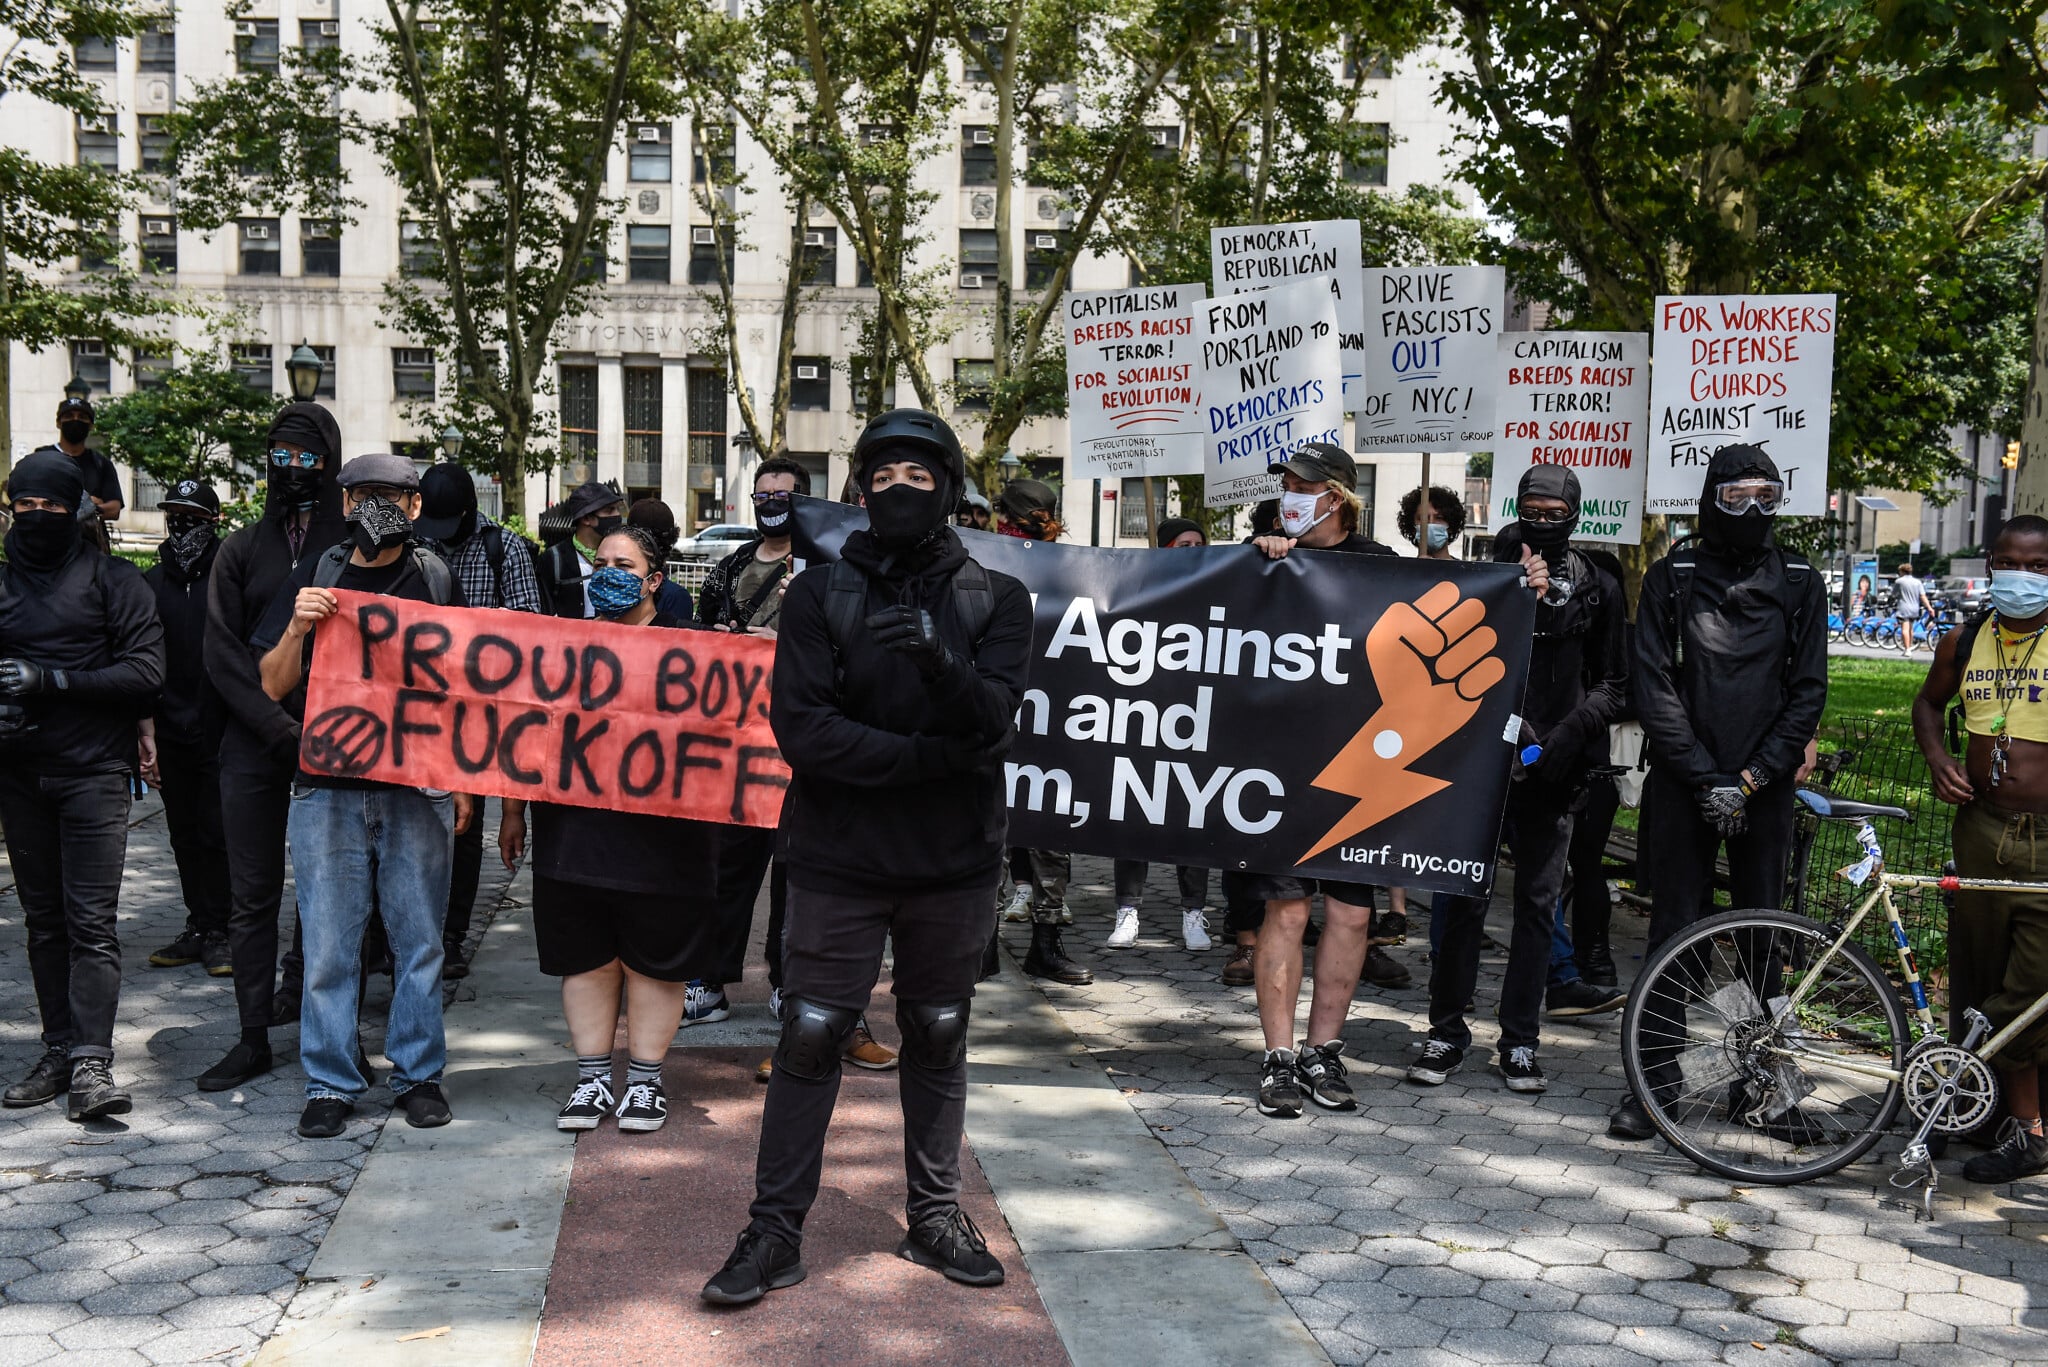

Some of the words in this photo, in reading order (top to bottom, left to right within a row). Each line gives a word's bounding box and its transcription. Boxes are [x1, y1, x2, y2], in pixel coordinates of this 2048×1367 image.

[1220, 228, 1316, 256] DEMOCRAT,
[1224, 247, 1337, 282] REPUBLICAN
[1382, 273, 1454, 304] DRIVE
[1071, 290, 1178, 320] CAPITALISM
[1208, 300, 1267, 335] FROM
[1664, 301, 1712, 333] FOR
[1719, 300, 1832, 333] WORKERS
[603, 325, 626, 341] OF
[633, 326, 672, 342] NEW
[1074, 320, 1134, 346] BREEDS
[1141, 316, 1195, 337] RACIST
[1382, 306, 1491, 338] FASCISTS
[1098, 339, 1175, 362] TERROR!
[1203, 325, 1303, 371] PORTLAND
[1310, 320, 1330, 340] TO
[1392, 336, 1447, 373] OUT
[1514, 340, 1624, 362] CAPITALISM
[1691, 335, 1800, 366] DEFENSE
[1075, 371, 1107, 392] FOR
[1117, 363, 1193, 386] SOCIALIST
[1240, 355, 1281, 393] NYC
[1508, 366, 1574, 386] BREEDS
[1580, 366, 1636, 387] RACIST
[1690, 368, 1787, 402] GUARDS
[1209, 379, 1324, 435] DEMOCRATS
[1365, 393, 1393, 417] OF
[1412, 386, 1473, 420] NYC!
[1529, 391, 1612, 414] TERROR!
[1505, 421, 1540, 440] FOR
[1548, 420, 1633, 443] SOCIALIST
[1661, 403, 1757, 436] AGAINST
[1763, 405, 1807, 431] THE
[1093, 436, 1156, 451] REVOLUTIONARY
[1217, 417, 1295, 465] PROTECT
[1360, 431, 1455, 447] INTERNATIONALIST
[1460, 431, 1494, 442] GROUP
[1087, 448, 1166, 463] INTERNATIONALIST
[1107, 461, 1133, 472] YOUTH
[1531, 446, 1633, 470] REVOLUTION
[357, 602, 623, 712] PROUD
[1045, 596, 1352, 687] Against
[1965, 668, 2038, 682] ABORTION
[1966, 687, 1992, 701] ARE
[1064, 685, 1213, 752] and
[1109, 757, 1285, 834] NYC
